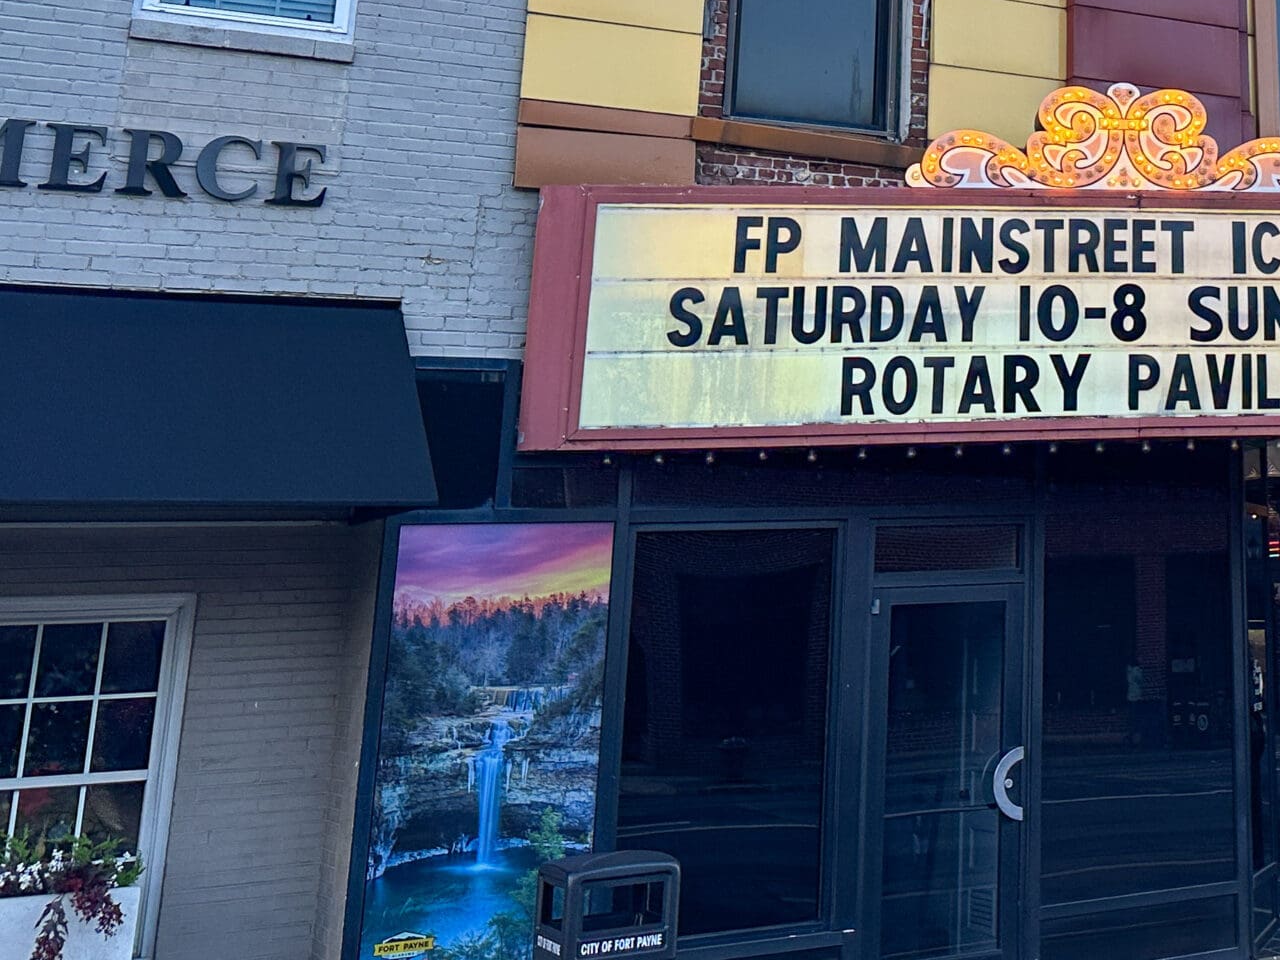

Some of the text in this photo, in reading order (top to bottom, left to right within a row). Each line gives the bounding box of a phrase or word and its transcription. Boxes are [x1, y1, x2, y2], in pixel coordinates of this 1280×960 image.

[733, 216, 802, 274] FP
[838, 216, 1194, 274] MAINSTREET
[666, 285, 986, 347] SATURDAY
[840, 353, 1092, 416] ROTARY
[378, 940, 430, 954] FORT PAYNE
[581, 933, 663, 956] CITY OF FORT PAYNE
